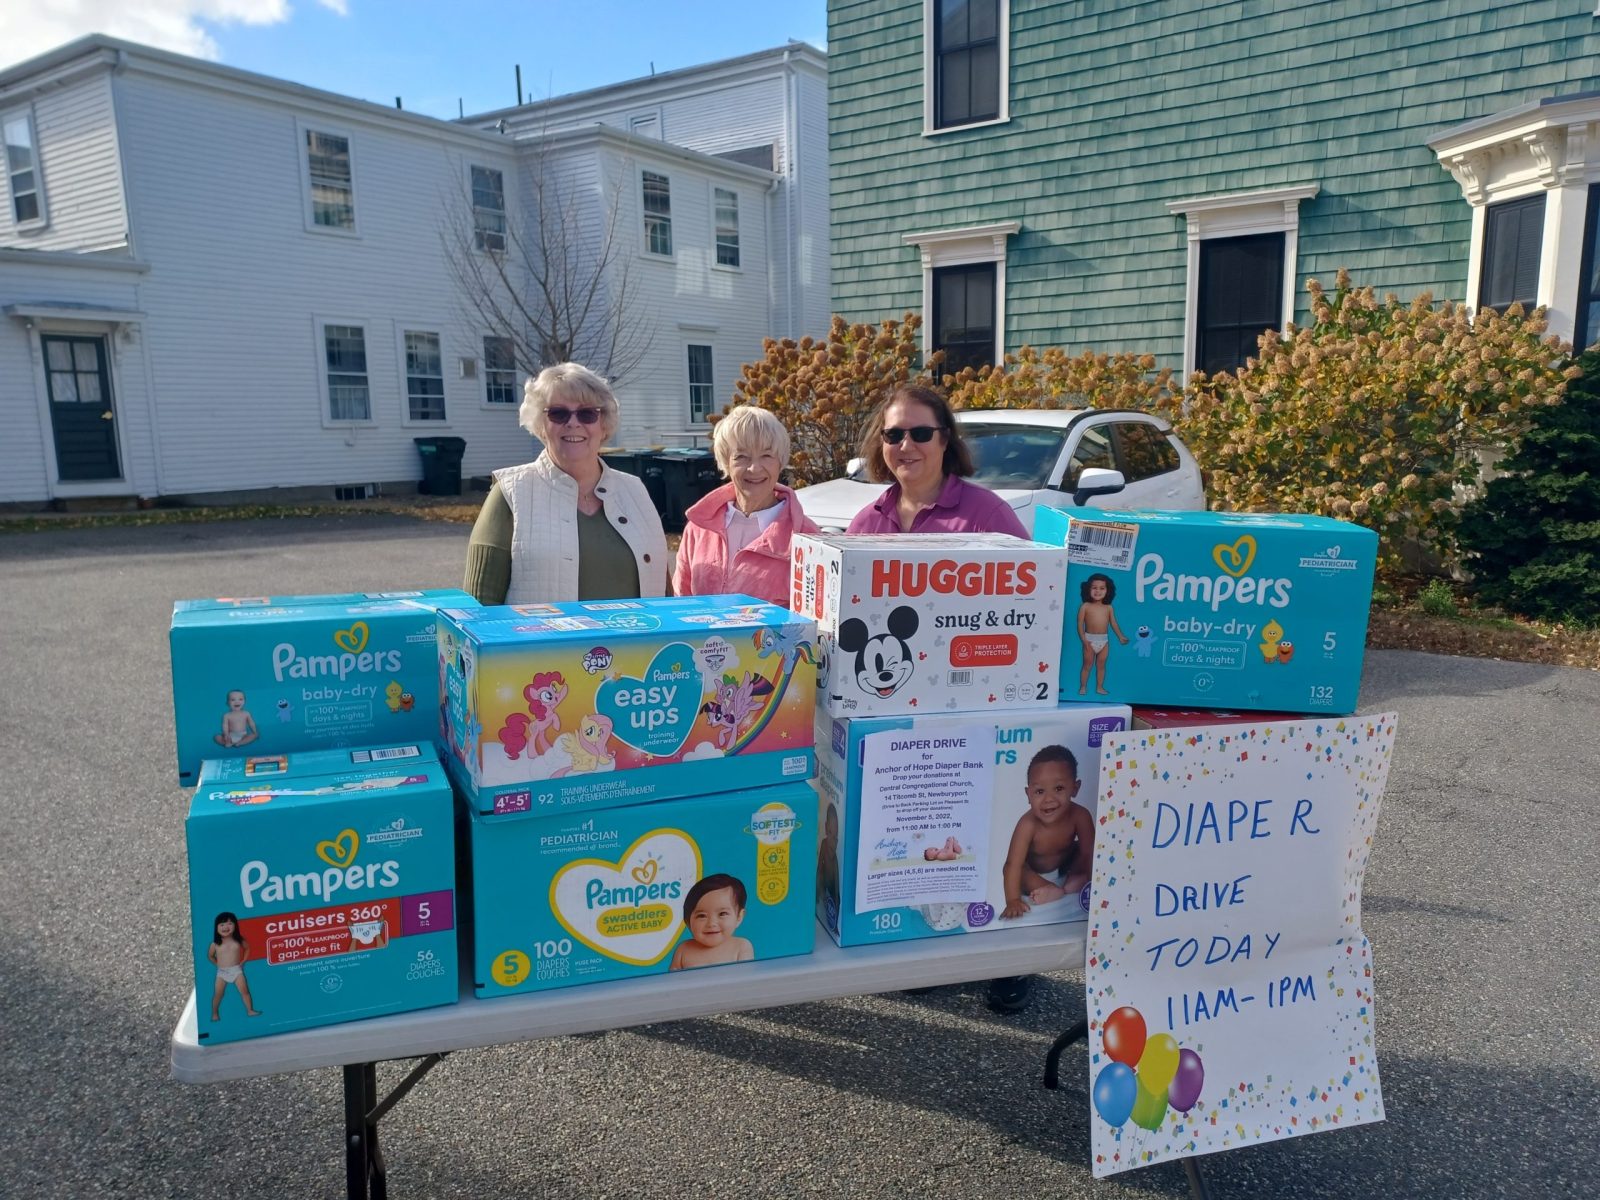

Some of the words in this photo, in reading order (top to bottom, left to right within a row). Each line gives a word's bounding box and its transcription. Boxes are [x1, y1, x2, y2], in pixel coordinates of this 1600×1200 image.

[831, 560, 839, 575] 2
[1302, 559, 1354, 568] PEDIATRICIAN
[871, 559, 1037, 597] HUGGIES
[1136, 553, 1292, 612] Pampers
[934, 611, 982, 631] snug
[985, 610, 999, 627] &
[1003, 609, 1036, 629] dry
[1164, 616, 1256, 640] baby-dry
[1323, 631, 1336, 650] 5
[272, 642, 401, 682] Pampers
[1172, 654, 1193, 664] days
[1196, 655, 1203, 663] &
[1206, 656, 1235, 665] nights
[653, 669, 690, 682] Pampers
[302, 684, 377, 701] baby-dry
[614, 685, 678, 707] easy
[1035, 682, 1049, 700] 2
[1310, 686, 1333, 698] 132
[313, 715, 331, 723] days
[334, 713, 339, 721] &
[341, 712, 365, 721] nights
[630, 707, 679, 731] ups
[643, 737, 680, 747] underwear
[648, 731, 675, 740] training
[891, 740, 930, 751] DIAPER
[933, 738, 967, 749] DRIVE
[875, 765, 902, 775] Anchor
[913, 763, 933, 773] Hope
[935, 762, 961, 772] Diaper
[963, 761, 984, 769] Bank
[561, 785, 588, 796] TRAINING
[590, 780, 627, 793] UNDERWEAR
[880, 784, 900, 792] Central
[902, 781, 948, 790] Congregational
[538, 793, 554, 805] 92
[928, 790, 968, 799] Newburyport
[581, 818, 594, 832] #1
[752, 819, 795, 831] SOFTEST
[896, 814, 927, 823] November
[1152, 799, 1320, 849] DIAPER
[369, 830, 420, 841] PEDIATRICIAN
[540, 830, 618, 846] PEDIATRICIAN
[540, 844, 589, 855] recommended
[868, 871, 887, 880] Larger
[240, 860, 400, 908] Pampers
[586, 879, 681, 909] Pampers
[1155, 875, 1252, 917] DRIVE
[418, 902, 430, 919] 5
[603, 910, 667, 924] swaddlers
[265, 912, 345, 934] cruisers
[607, 923, 639, 933] ACTIVE
[641, 919, 663, 929] BABY
[872, 912, 901, 930] 180
[284, 936, 311, 949] 100%
[311, 932, 349, 943] LEAKPROOF
[278, 946, 327, 961] gap-free
[330, 942, 341, 951] fit
[534, 938, 572, 959] 100
[1146, 933, 1281, 971] TODAY
[288, 959, 323, 971] ajustement
[340, 953, 370, 963] ouverture
[417, 950, 433, 962] 56
[317, 965, 329, 973] 100
[410, 959, 441, 972] DIAPERS
[504, 954, 519, 975] 5
[537, 957, 570, 971] DIAPERS
[406, 966, 445, 980] COUCHES
[536, 968, 570, 980] COUCHES
